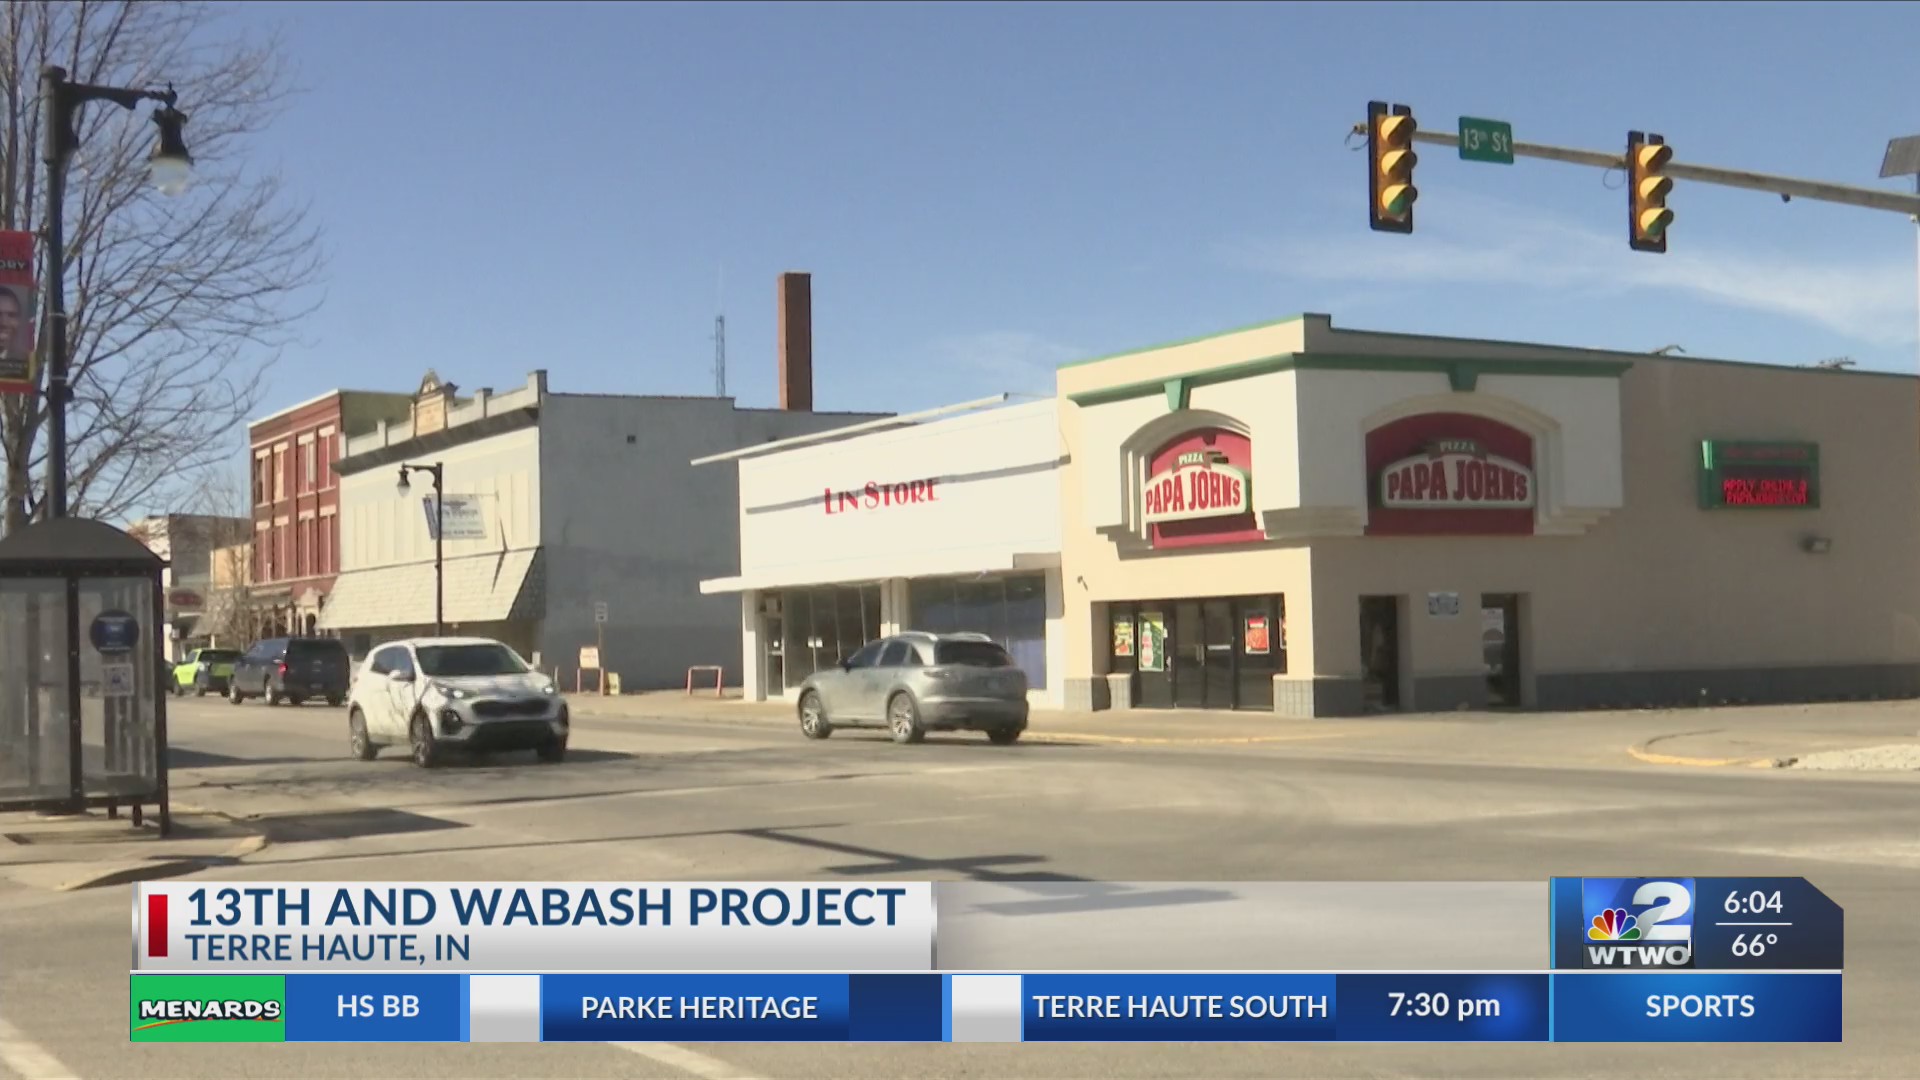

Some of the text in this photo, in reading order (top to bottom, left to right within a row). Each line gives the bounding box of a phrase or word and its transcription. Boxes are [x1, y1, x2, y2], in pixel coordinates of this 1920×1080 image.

[1492, 131, 1508, 153] St
[1439, 441, 1475, 452] PIZZA
[1178, 451, 1204, 465] PIZZA
[1388, 459, 1528, 502] PAPA JOHNS
[1145, 470, 1241, 515] PAPA JOHNS
